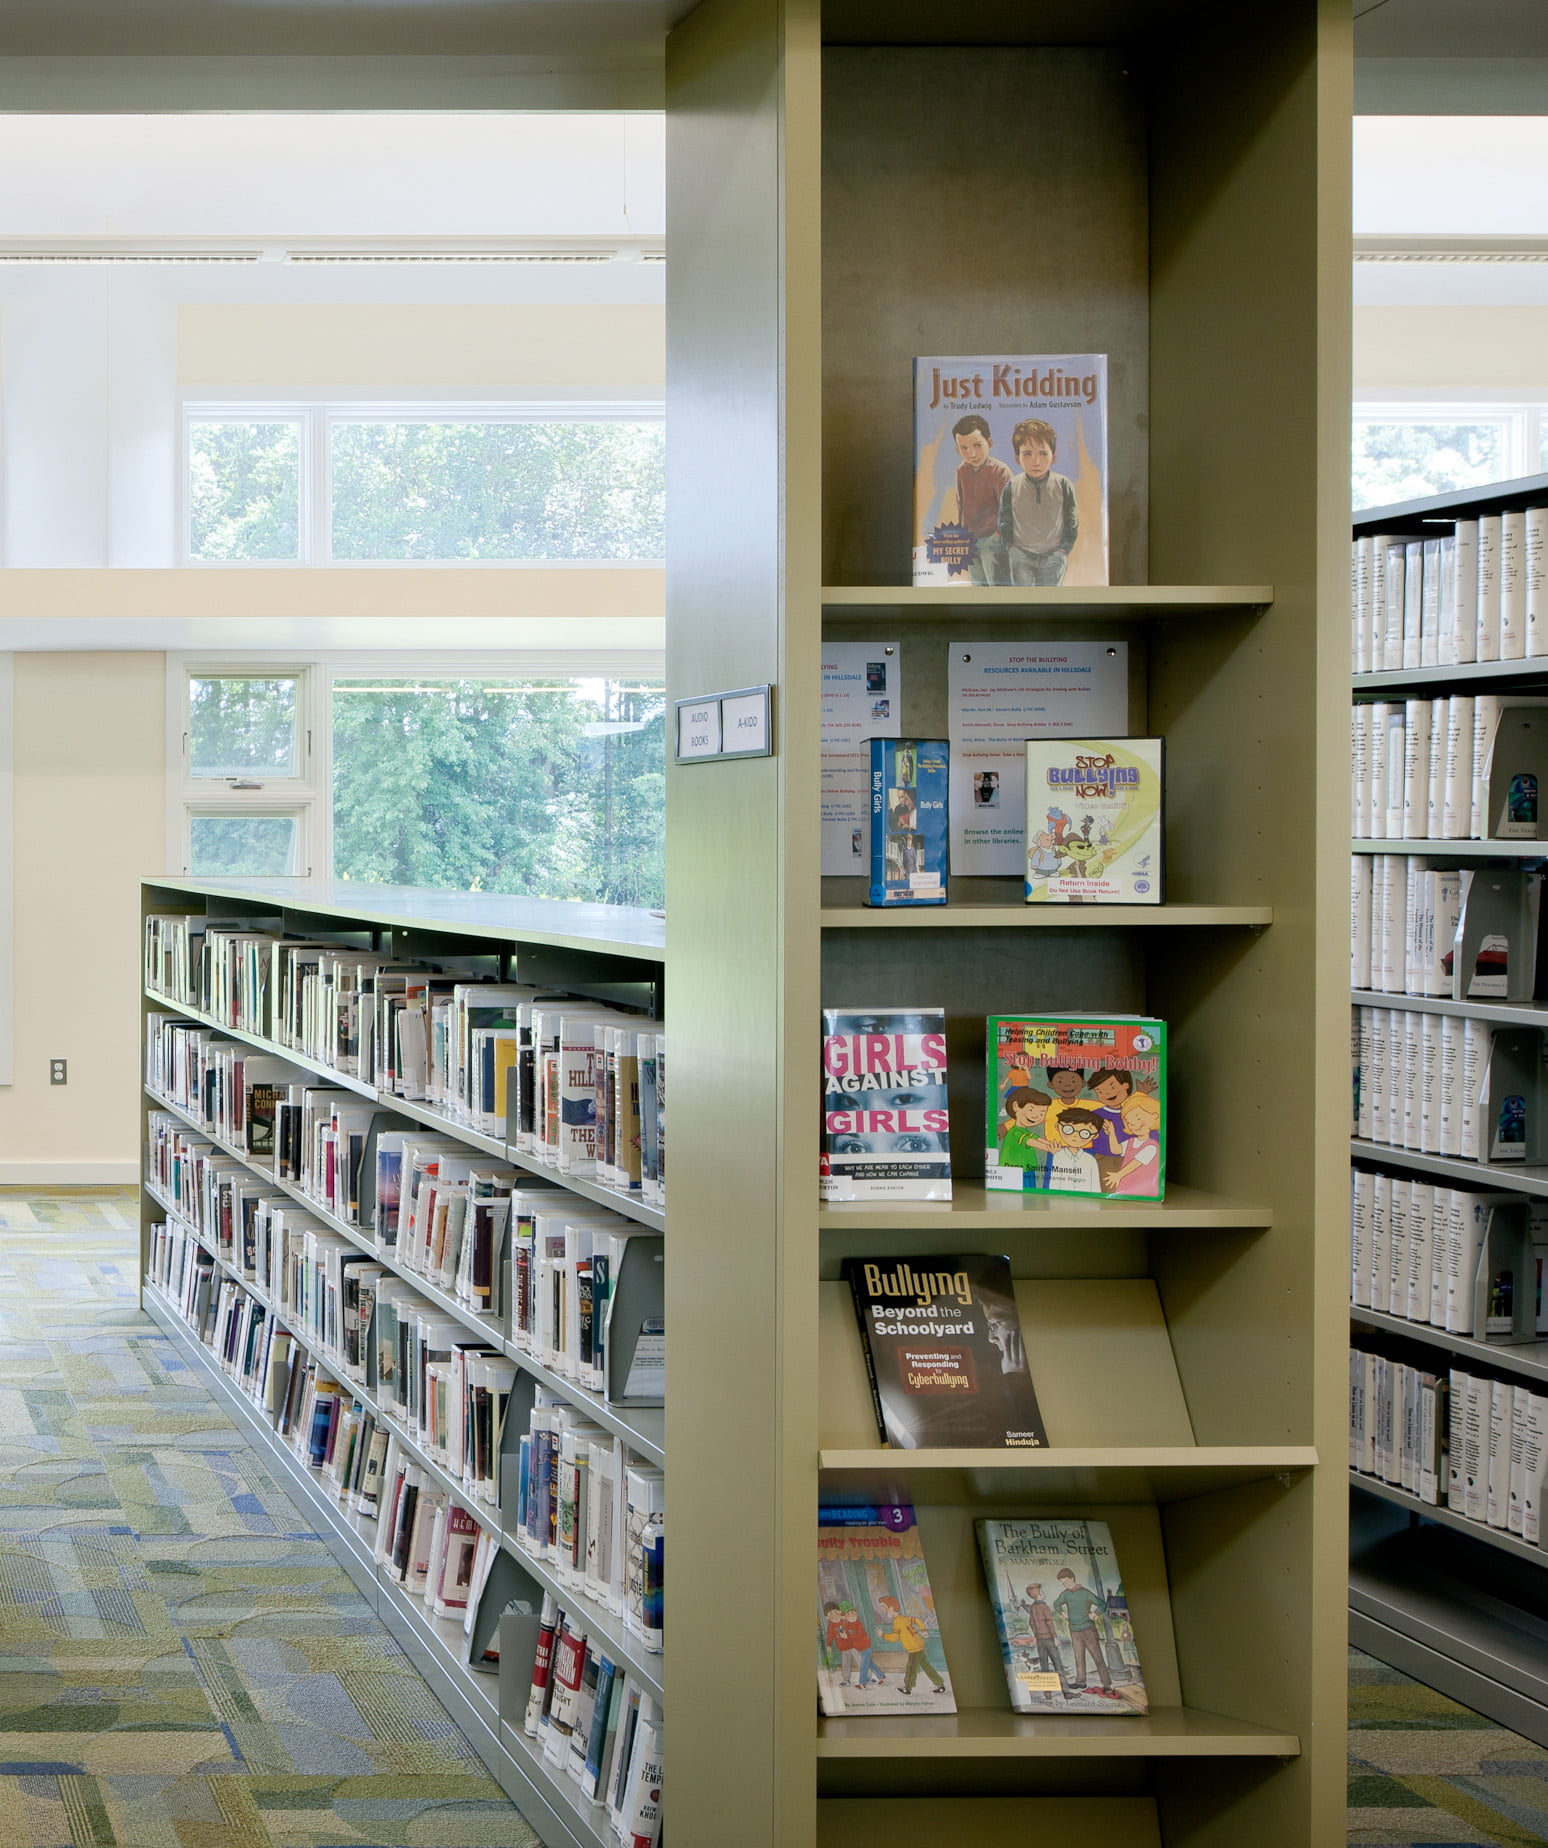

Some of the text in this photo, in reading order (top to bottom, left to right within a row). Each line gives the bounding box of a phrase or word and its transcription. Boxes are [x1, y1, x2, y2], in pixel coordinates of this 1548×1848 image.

[929, 364, 1098, 409] Just Kidding
[950, 402, 968, 411] Trudy
[969, 402, 992, 411] Ludwig
[1029, 401, 1048, 409] Adam
[1048, 401, 1082, 409] Gustavson
[932, 547, 970, 555] MY SECRET
[941, 556, 961, 565] BULLY
[692, 712, 709, 723] AUDIO
[691, 735, 709, 747] BOOKS
[1076, 754, 1115, 769] STOP
[872, 771, 883, 814] Bully Girls
[1076, 784, 1108, 798] NOW
[920, 801, 944, 810] Bully Girls
[1005, 1028, 1034, 1037] Helping
[1035, 1029, 1068, 1037] Children
[1070, 1029, 1091, 1039] Cope
[1006, 1036, 1034, 1045] Teasing
[1052, 1037, 1084, 1047] Bullying
[824, 1034, 948, 1078] GIRLS
[1003, 1052, 1157, 1075] Stop Bullying Bobby!
[569, 1070, 595, 1087] HILL
[825, 1068, 948, 1095] AGAINST
[826, 1110, 949, 1134] GIRLS
[571, 1129, 595, 1143] THE
[586, 1144, 596, 1158] W
[820, 1156, 829, 1166] A
[1026, 1164, 1082, 1175] Smith-Mansell
[595, 1261, 606, 1284] S
[864, 1264, 973, 1306] Bullying
[872, 1305, 962, 1320] Beyond the
[875, 1322, 975, 1338] Schoolyard
[906, 1353, 950, 1362] Preventing
[912, 1361, 959, 1369] Responding
[908, 1373, 969, 1389] Cyberbullying
[1005, 1439, 1040, 1447] Hinduja
[832, 1510, 868, 1519] READING
[892, 1508, 903, 1524] 3
[1000, 1524, 1087, 1544] The Bully of
[818, 1537, 901, 1550] ully Trouble
[996, 1540, 1110, 1556] Barkham Street
[1010, 1558, 1034, 1566] MARY
[1038, 1558, 1067, 1566] STOLZ
[645, 1762, 657, 1773] THE
